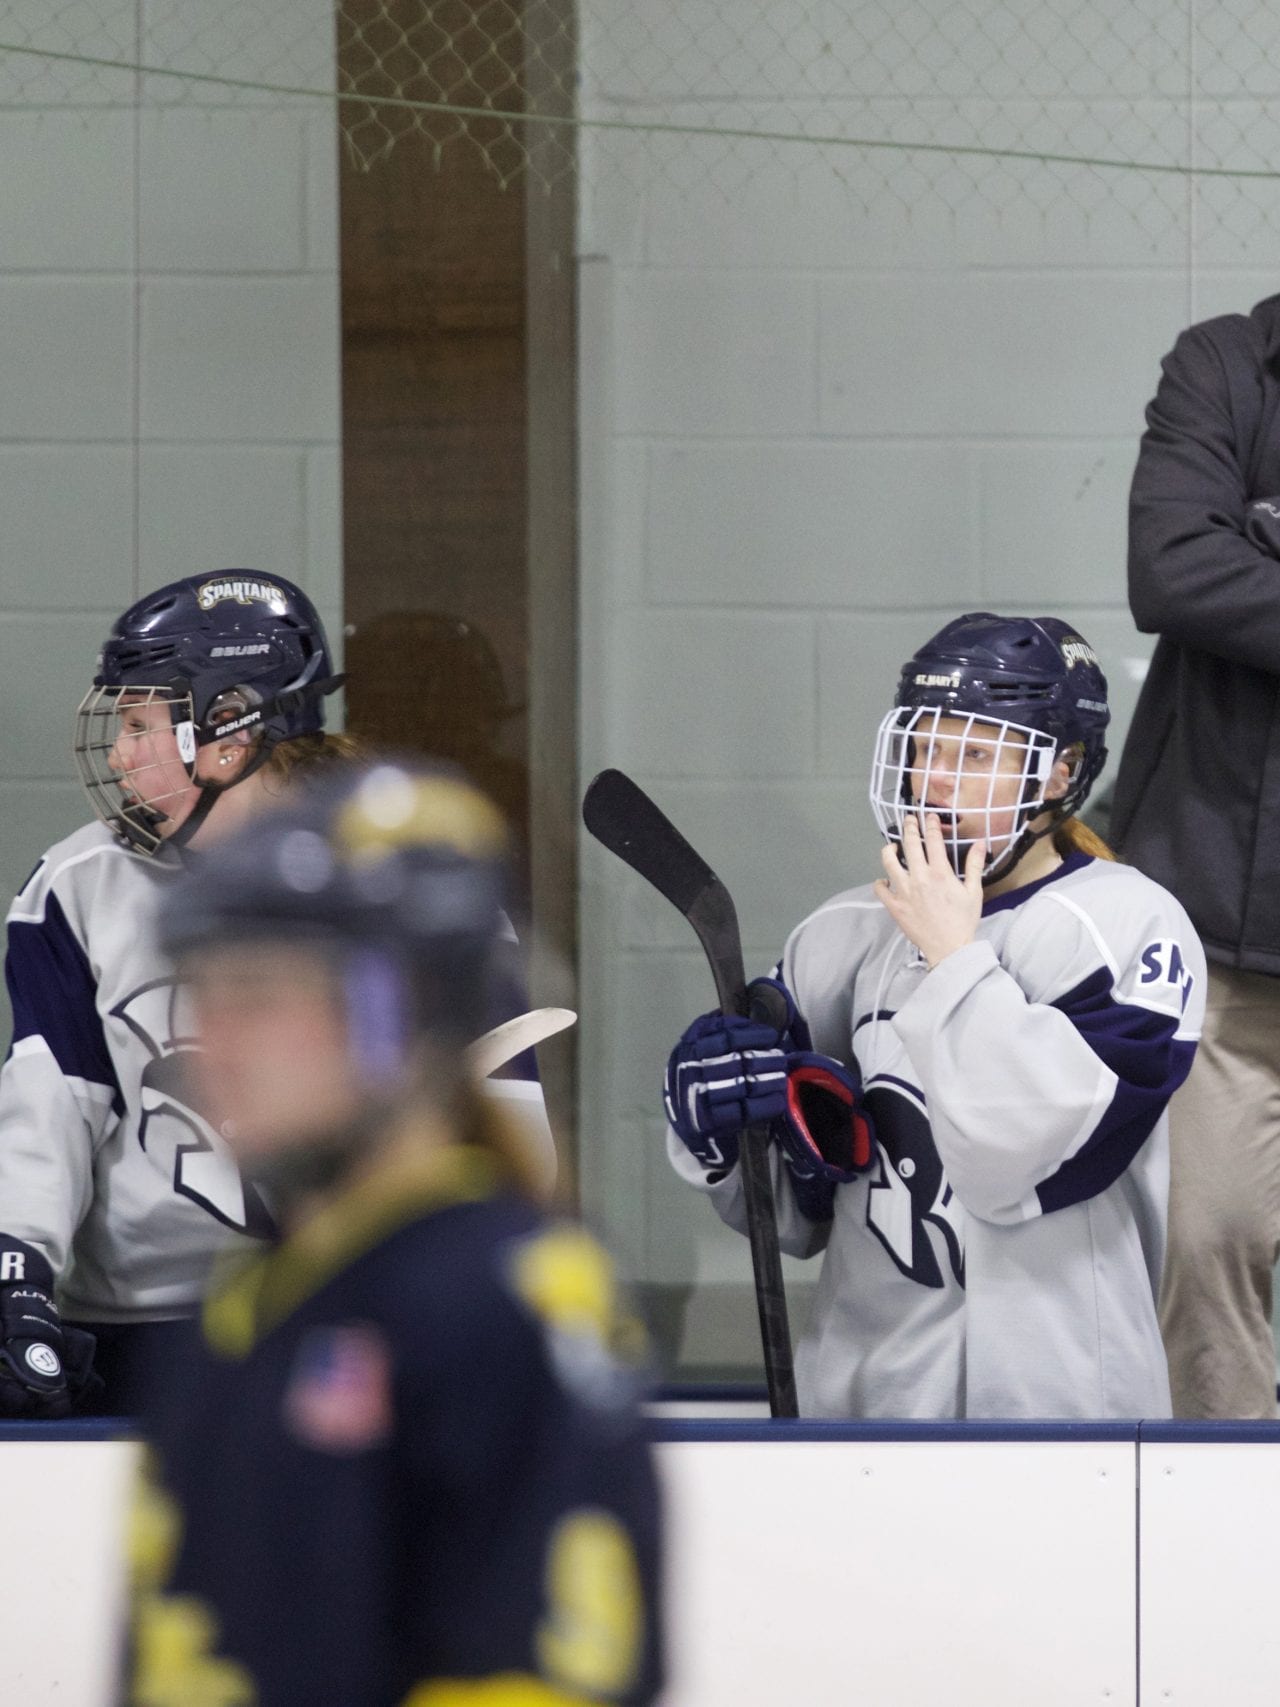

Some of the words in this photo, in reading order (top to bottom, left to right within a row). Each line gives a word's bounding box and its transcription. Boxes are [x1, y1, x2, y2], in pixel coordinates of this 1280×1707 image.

[202, 582, 283, 607] SPARTANS
[210, 644, 270, 657] BAUER
[216, 711, 260, 736] BAUER
[0, 1251, 25, 1280] R
